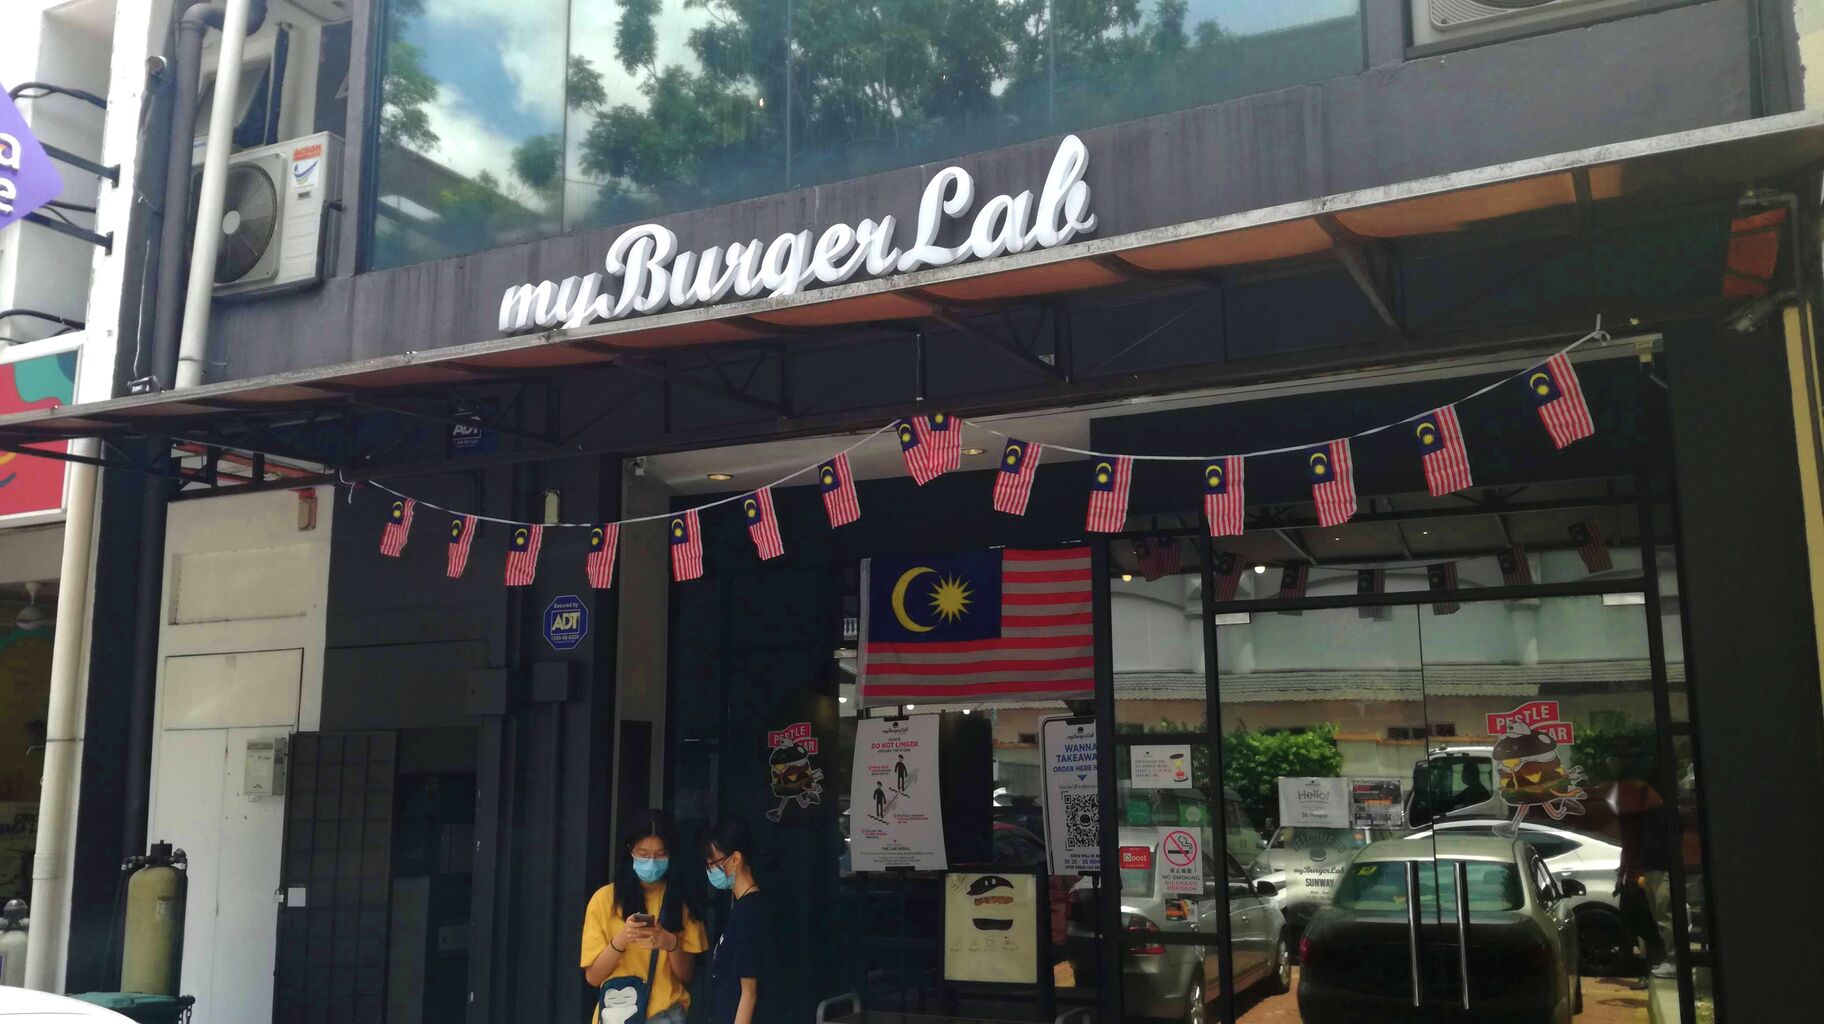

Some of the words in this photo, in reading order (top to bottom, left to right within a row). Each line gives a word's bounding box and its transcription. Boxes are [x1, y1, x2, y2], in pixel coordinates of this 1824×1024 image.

[497, 133, 1098, 333] myBurgerLab
[573, 601, 579, 609] by
[551, 611, 580, 631] ADT
[895, 740, 919, 748] LINGER
[1064, 743, 1097, 753] WANNA
[1056, 752, 1098, 763] TAKEAWA
[1053, 765, 1074, 773] ORDER
[1075, 764, 1093, 772] HERE
[1297, 790, 1330, 801] Hello!
[1293, 865, 1345, 876] myBurgerLab
[1305, 878, 1335, 887] SUNWAY
